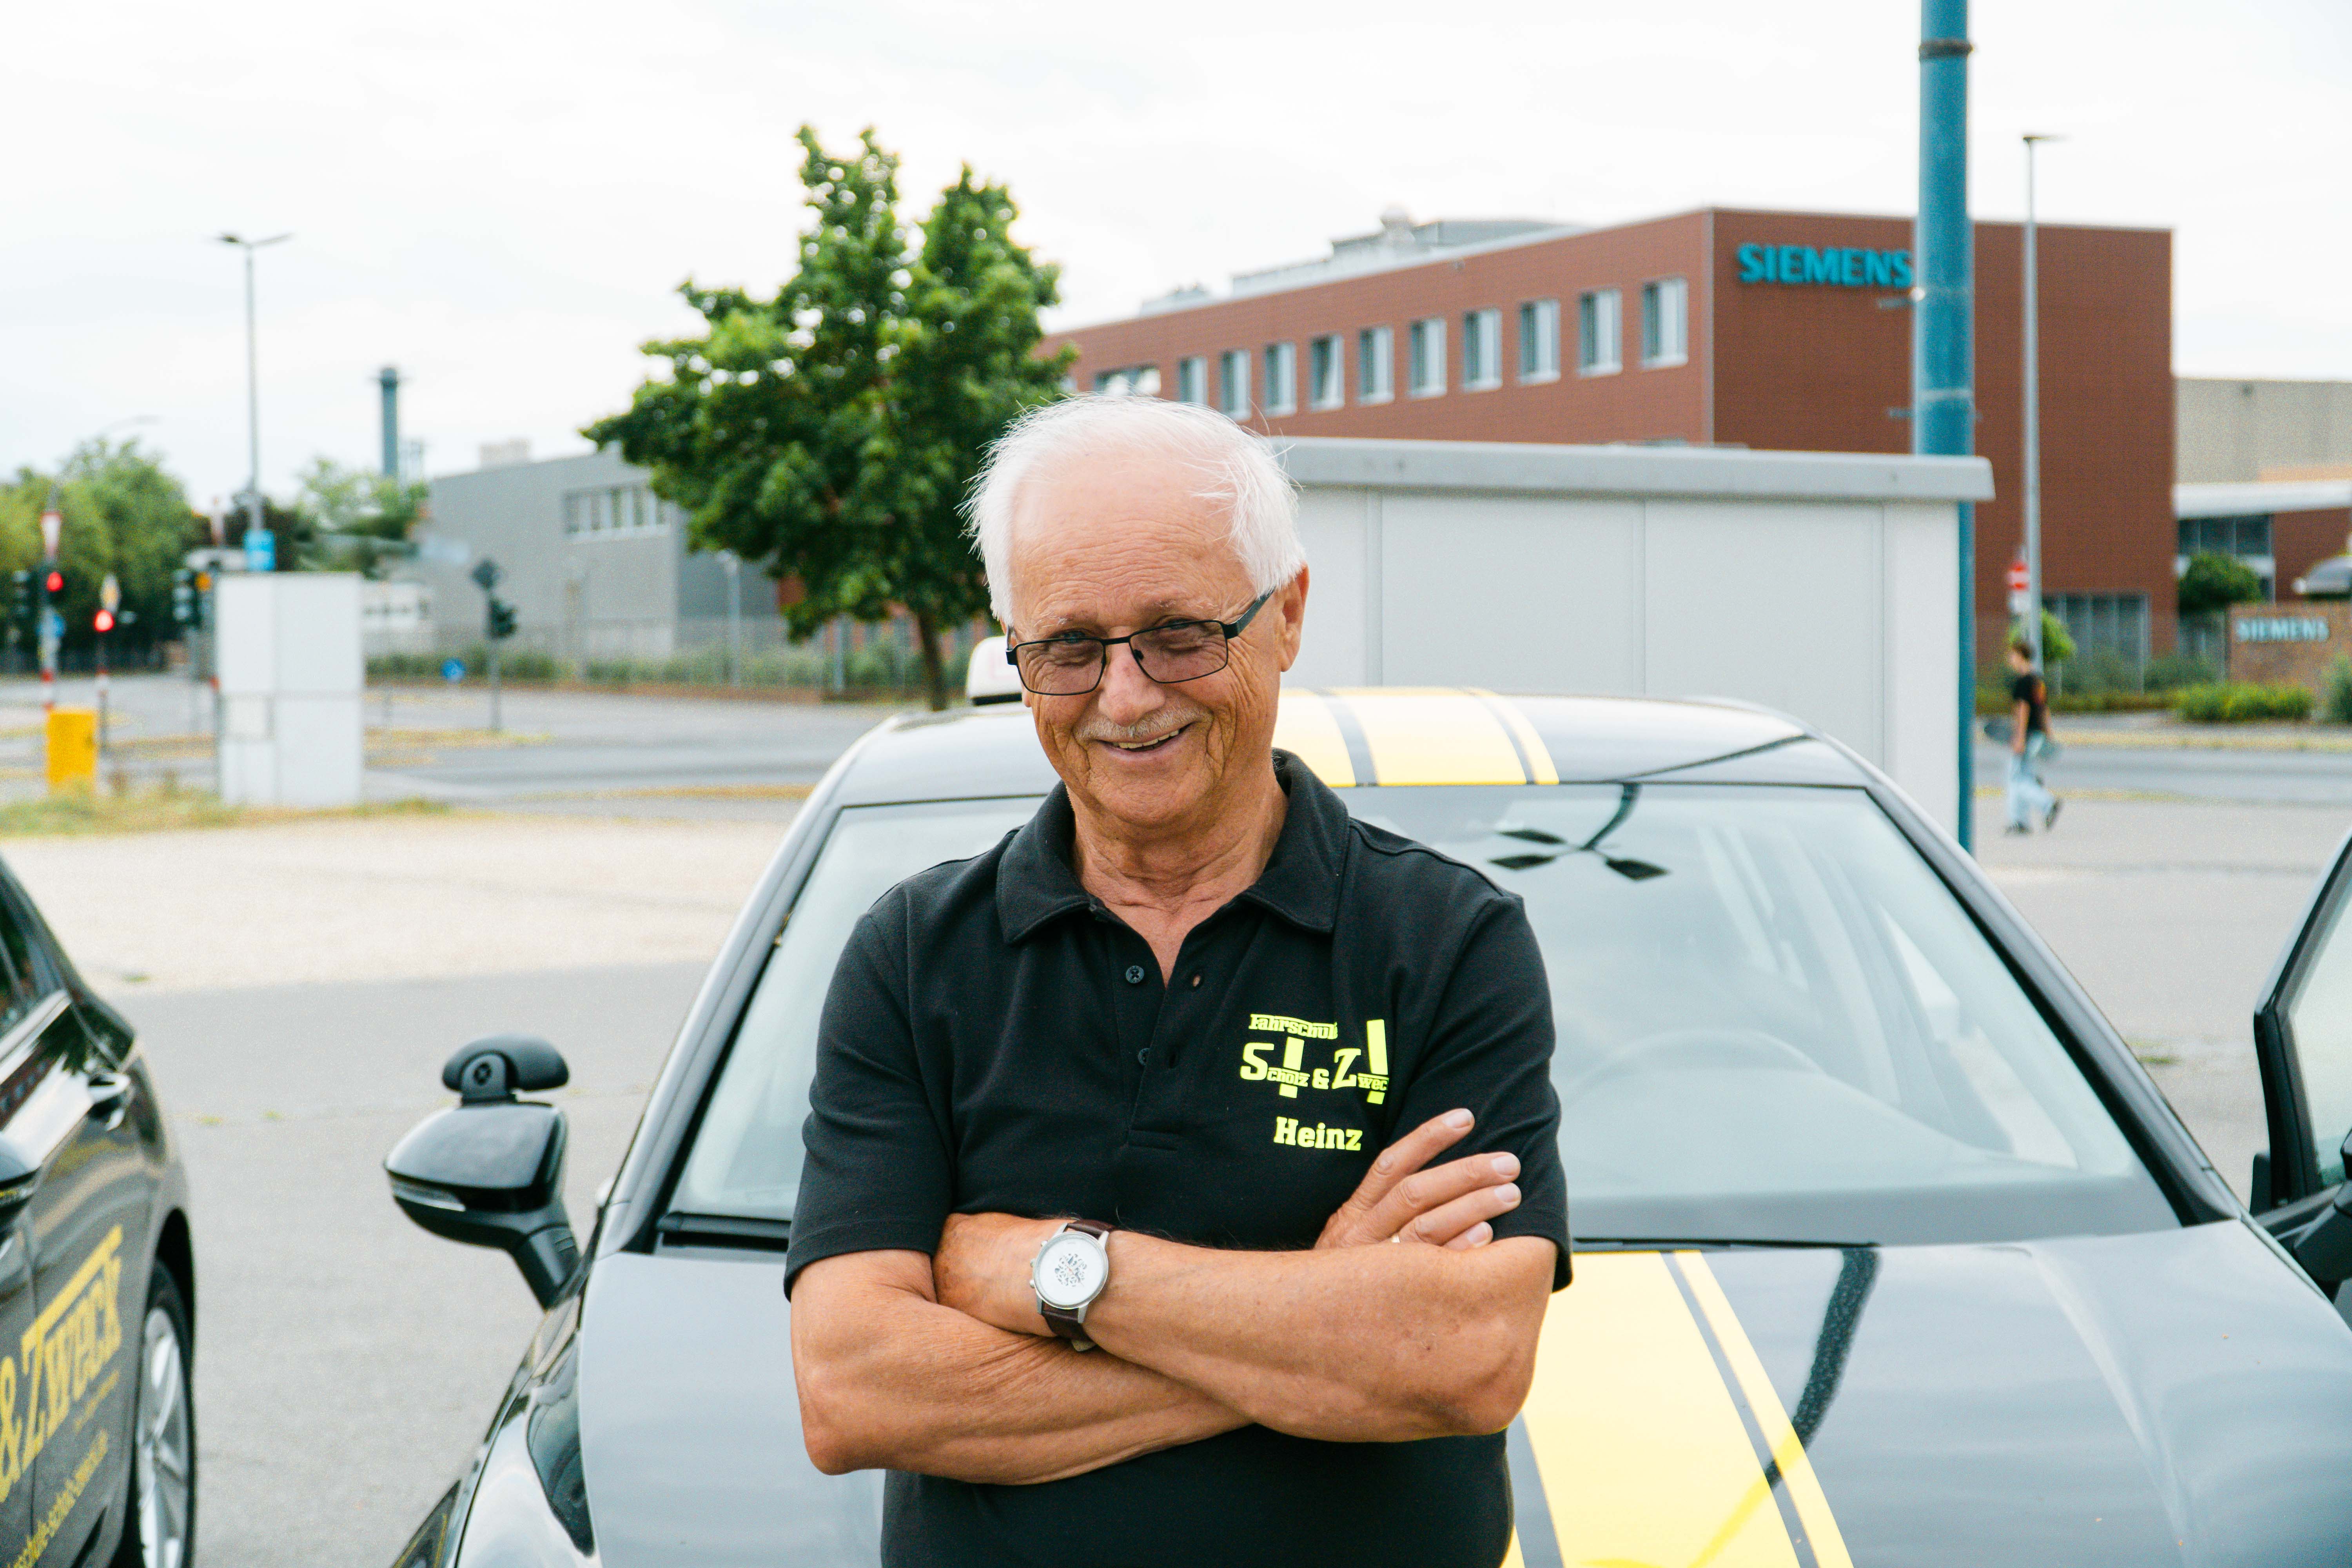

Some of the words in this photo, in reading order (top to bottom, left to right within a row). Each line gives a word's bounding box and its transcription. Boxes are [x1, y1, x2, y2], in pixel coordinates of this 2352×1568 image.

[1737, 243, 1912, 288] SIEMENS
[2236, 617, 2329, 642] SIEMENS
[1312, 1068, 1329, 1089] &
[1332, 1048, 1389, 1091] Zwec
[1274, 1116, 1363, 1151] Heinz
[0, 1356, 22, 1503] &
